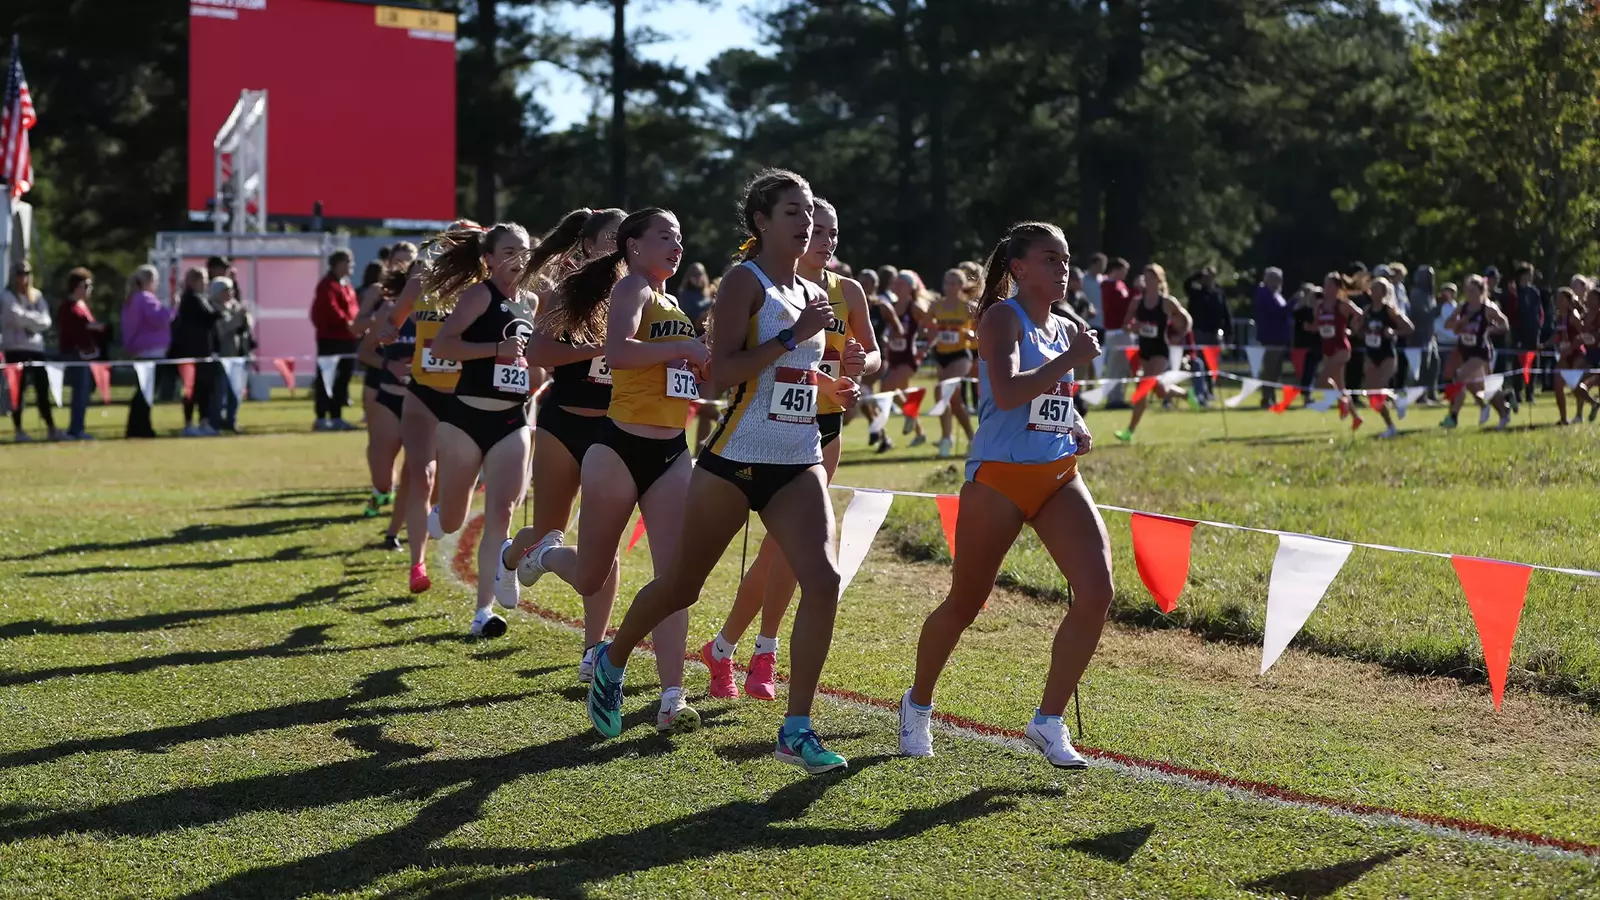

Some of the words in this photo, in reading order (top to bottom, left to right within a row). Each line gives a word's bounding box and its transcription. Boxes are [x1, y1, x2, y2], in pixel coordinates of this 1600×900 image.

[649, 320, 696, 339] MIZZ
[501, 368, 526, 387] 323
[674, 373, 697, 396] 373
[780, 388, 814, 412] 451
[1039, 399, 1069, 423] 457
